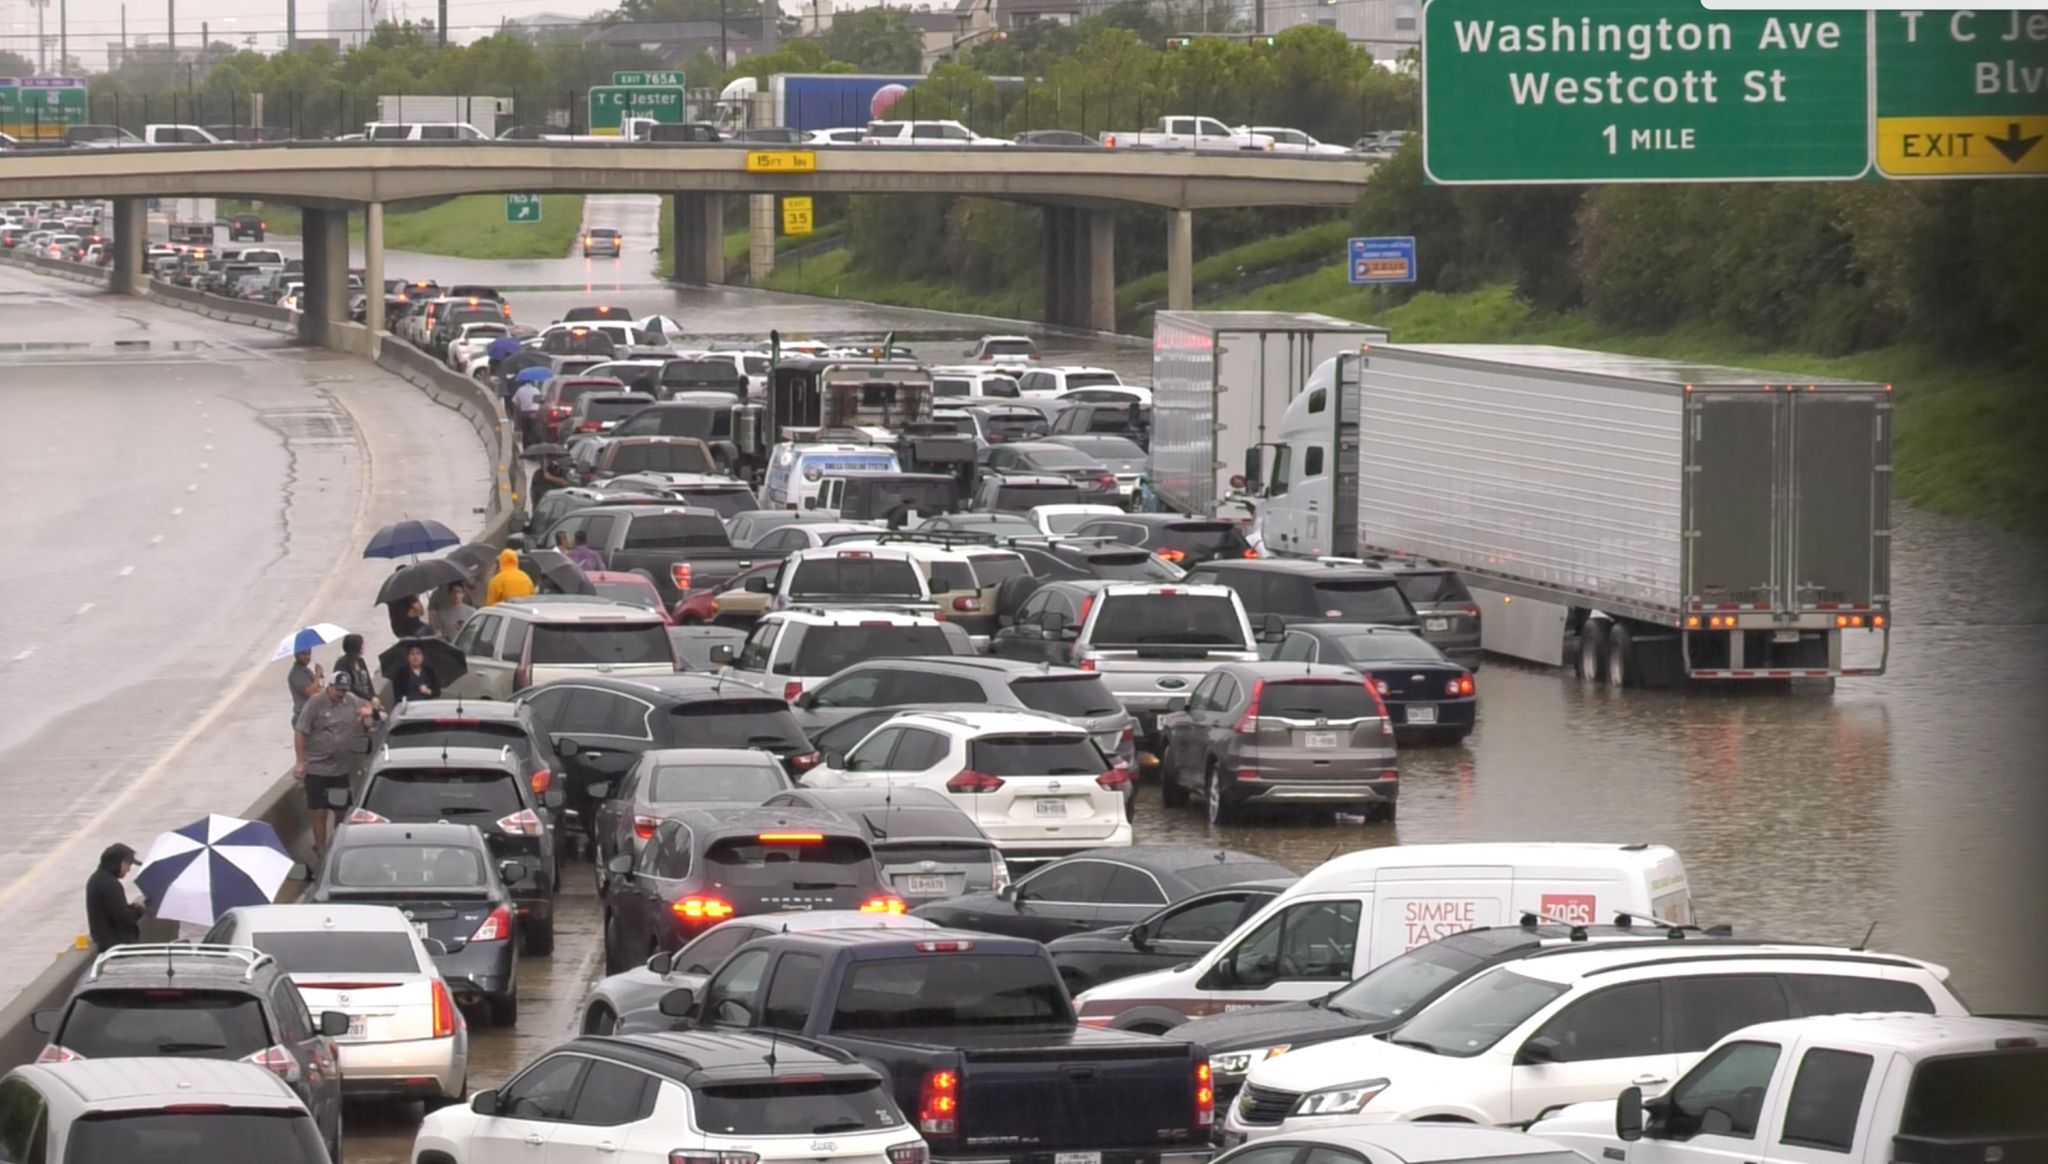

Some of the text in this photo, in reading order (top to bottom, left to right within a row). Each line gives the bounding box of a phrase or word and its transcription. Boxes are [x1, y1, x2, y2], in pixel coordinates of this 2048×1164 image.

[1453, 16, 1841, 60] Washington Ave
[1900, 10, 1925, 43] T
[1950, 10, 1977, 42] C
[621, 73, 677, 84] EXIT 765A
[1509, 69, 1787, 105] Westcott St
[1975, 60, 2048, 94] Blv
[597, 93, 677, 104] T C Jester
[1602, 124, 1696, 155] 1 MILE
[1903, 133, 1974, 157] EXIT
[788, 212, 808, 224] 35
[1406, 902, 1475, 921] SIMPLE
[1406, 923, 1473, 945] TAST
